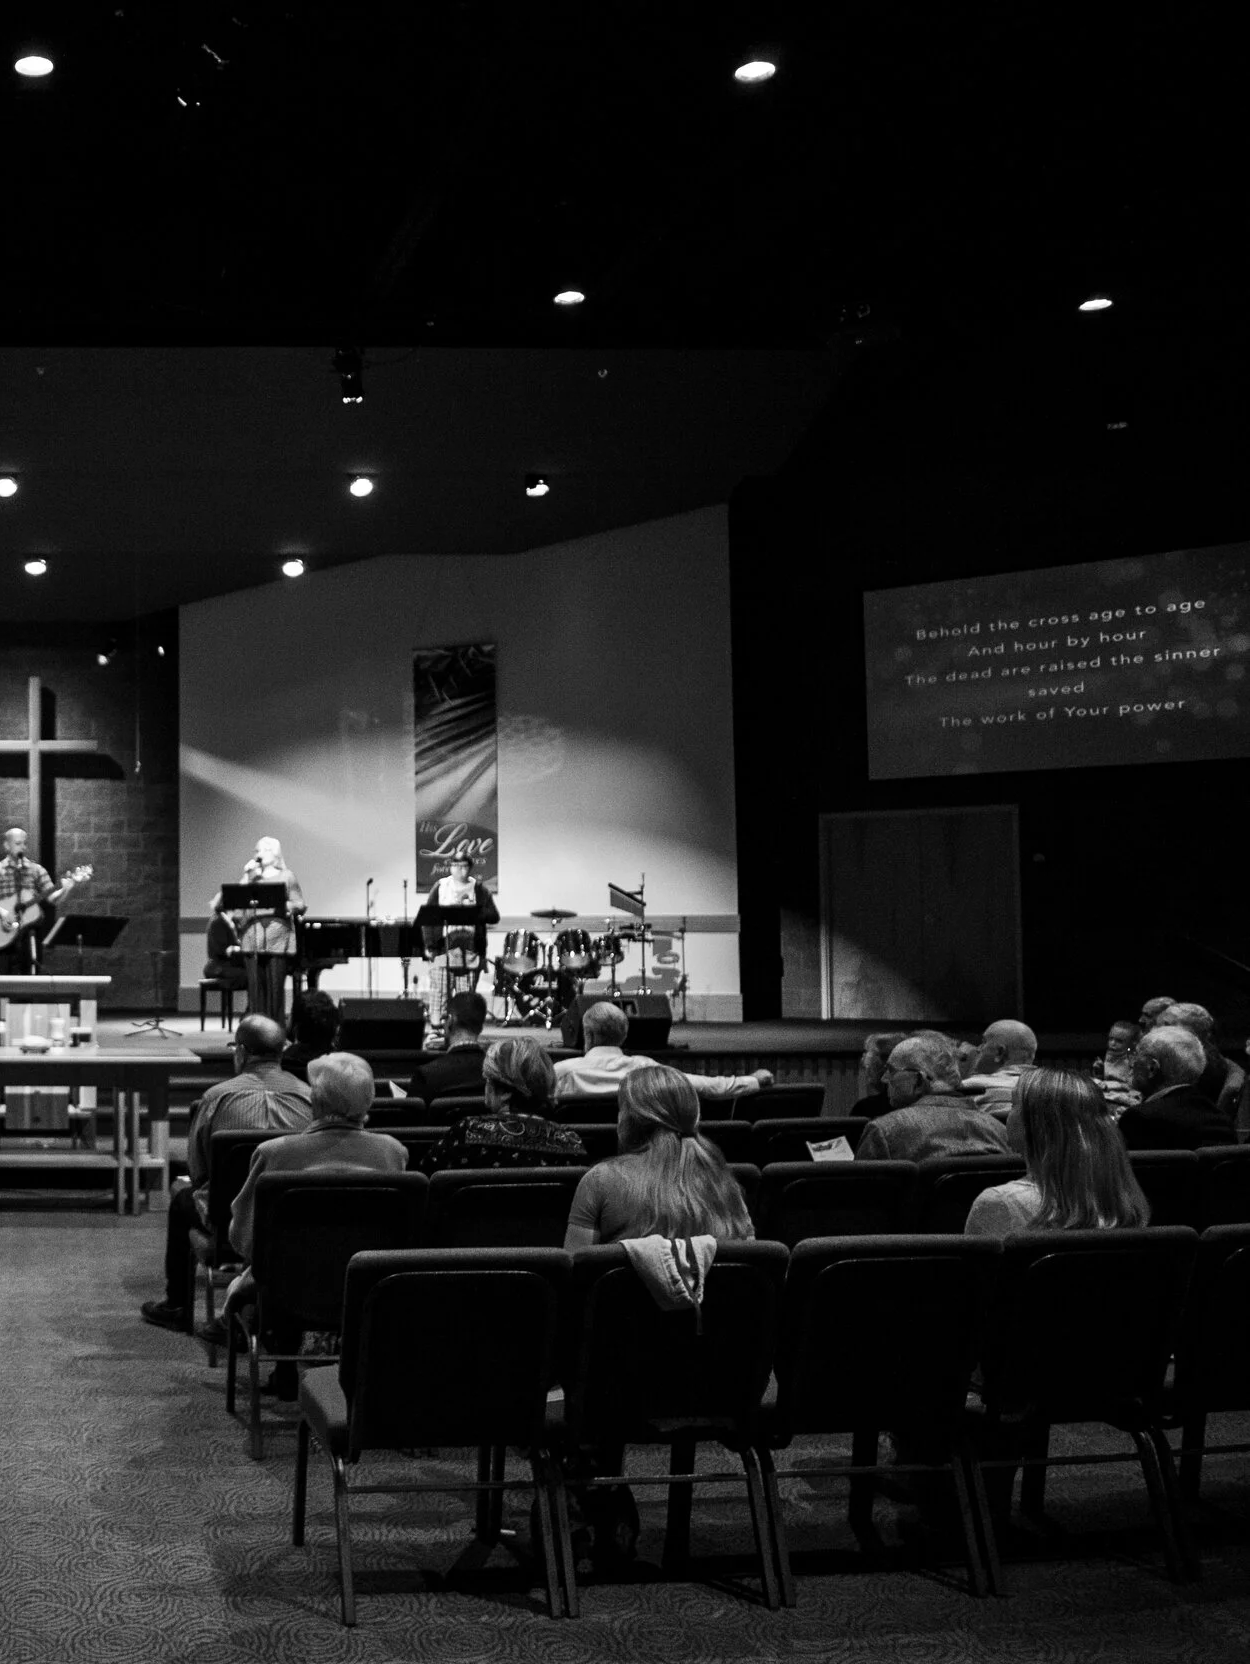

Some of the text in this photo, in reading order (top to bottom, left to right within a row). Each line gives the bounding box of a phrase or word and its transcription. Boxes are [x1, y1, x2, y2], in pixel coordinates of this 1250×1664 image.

[916, 599, 1206, 641] Behold the cross age to age
[967, 629, 1147, 657] And hour by hour
[905, 646, 1221, 686] The dead are raised the sinner
[1028, 682, 1085, 698] saved
[940, 699, 1185, 727] The work of Your power
[419, 822, 494, 857] Love
